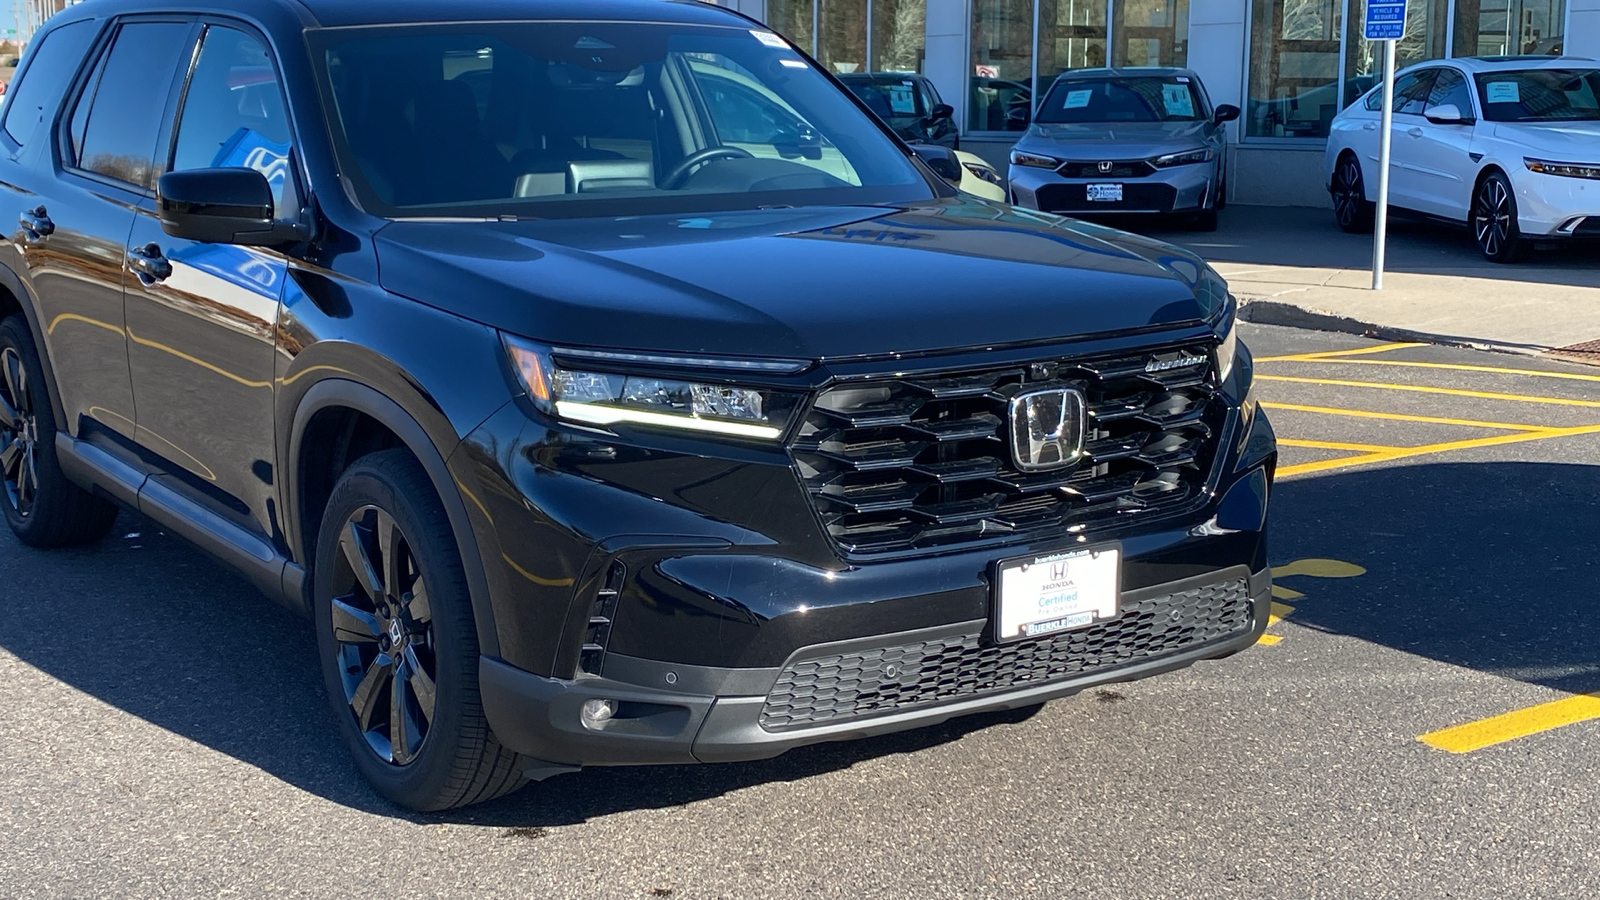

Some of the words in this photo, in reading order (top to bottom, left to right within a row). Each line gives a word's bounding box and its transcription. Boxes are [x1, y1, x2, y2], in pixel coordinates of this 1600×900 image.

[1042, 580, 1074, 591] HONDA
[1038, 591, 1078, 607] Certified
[1028, 619, 1067, 634] BUERKLE
[1067, 615, 1090, 627] HONDA
